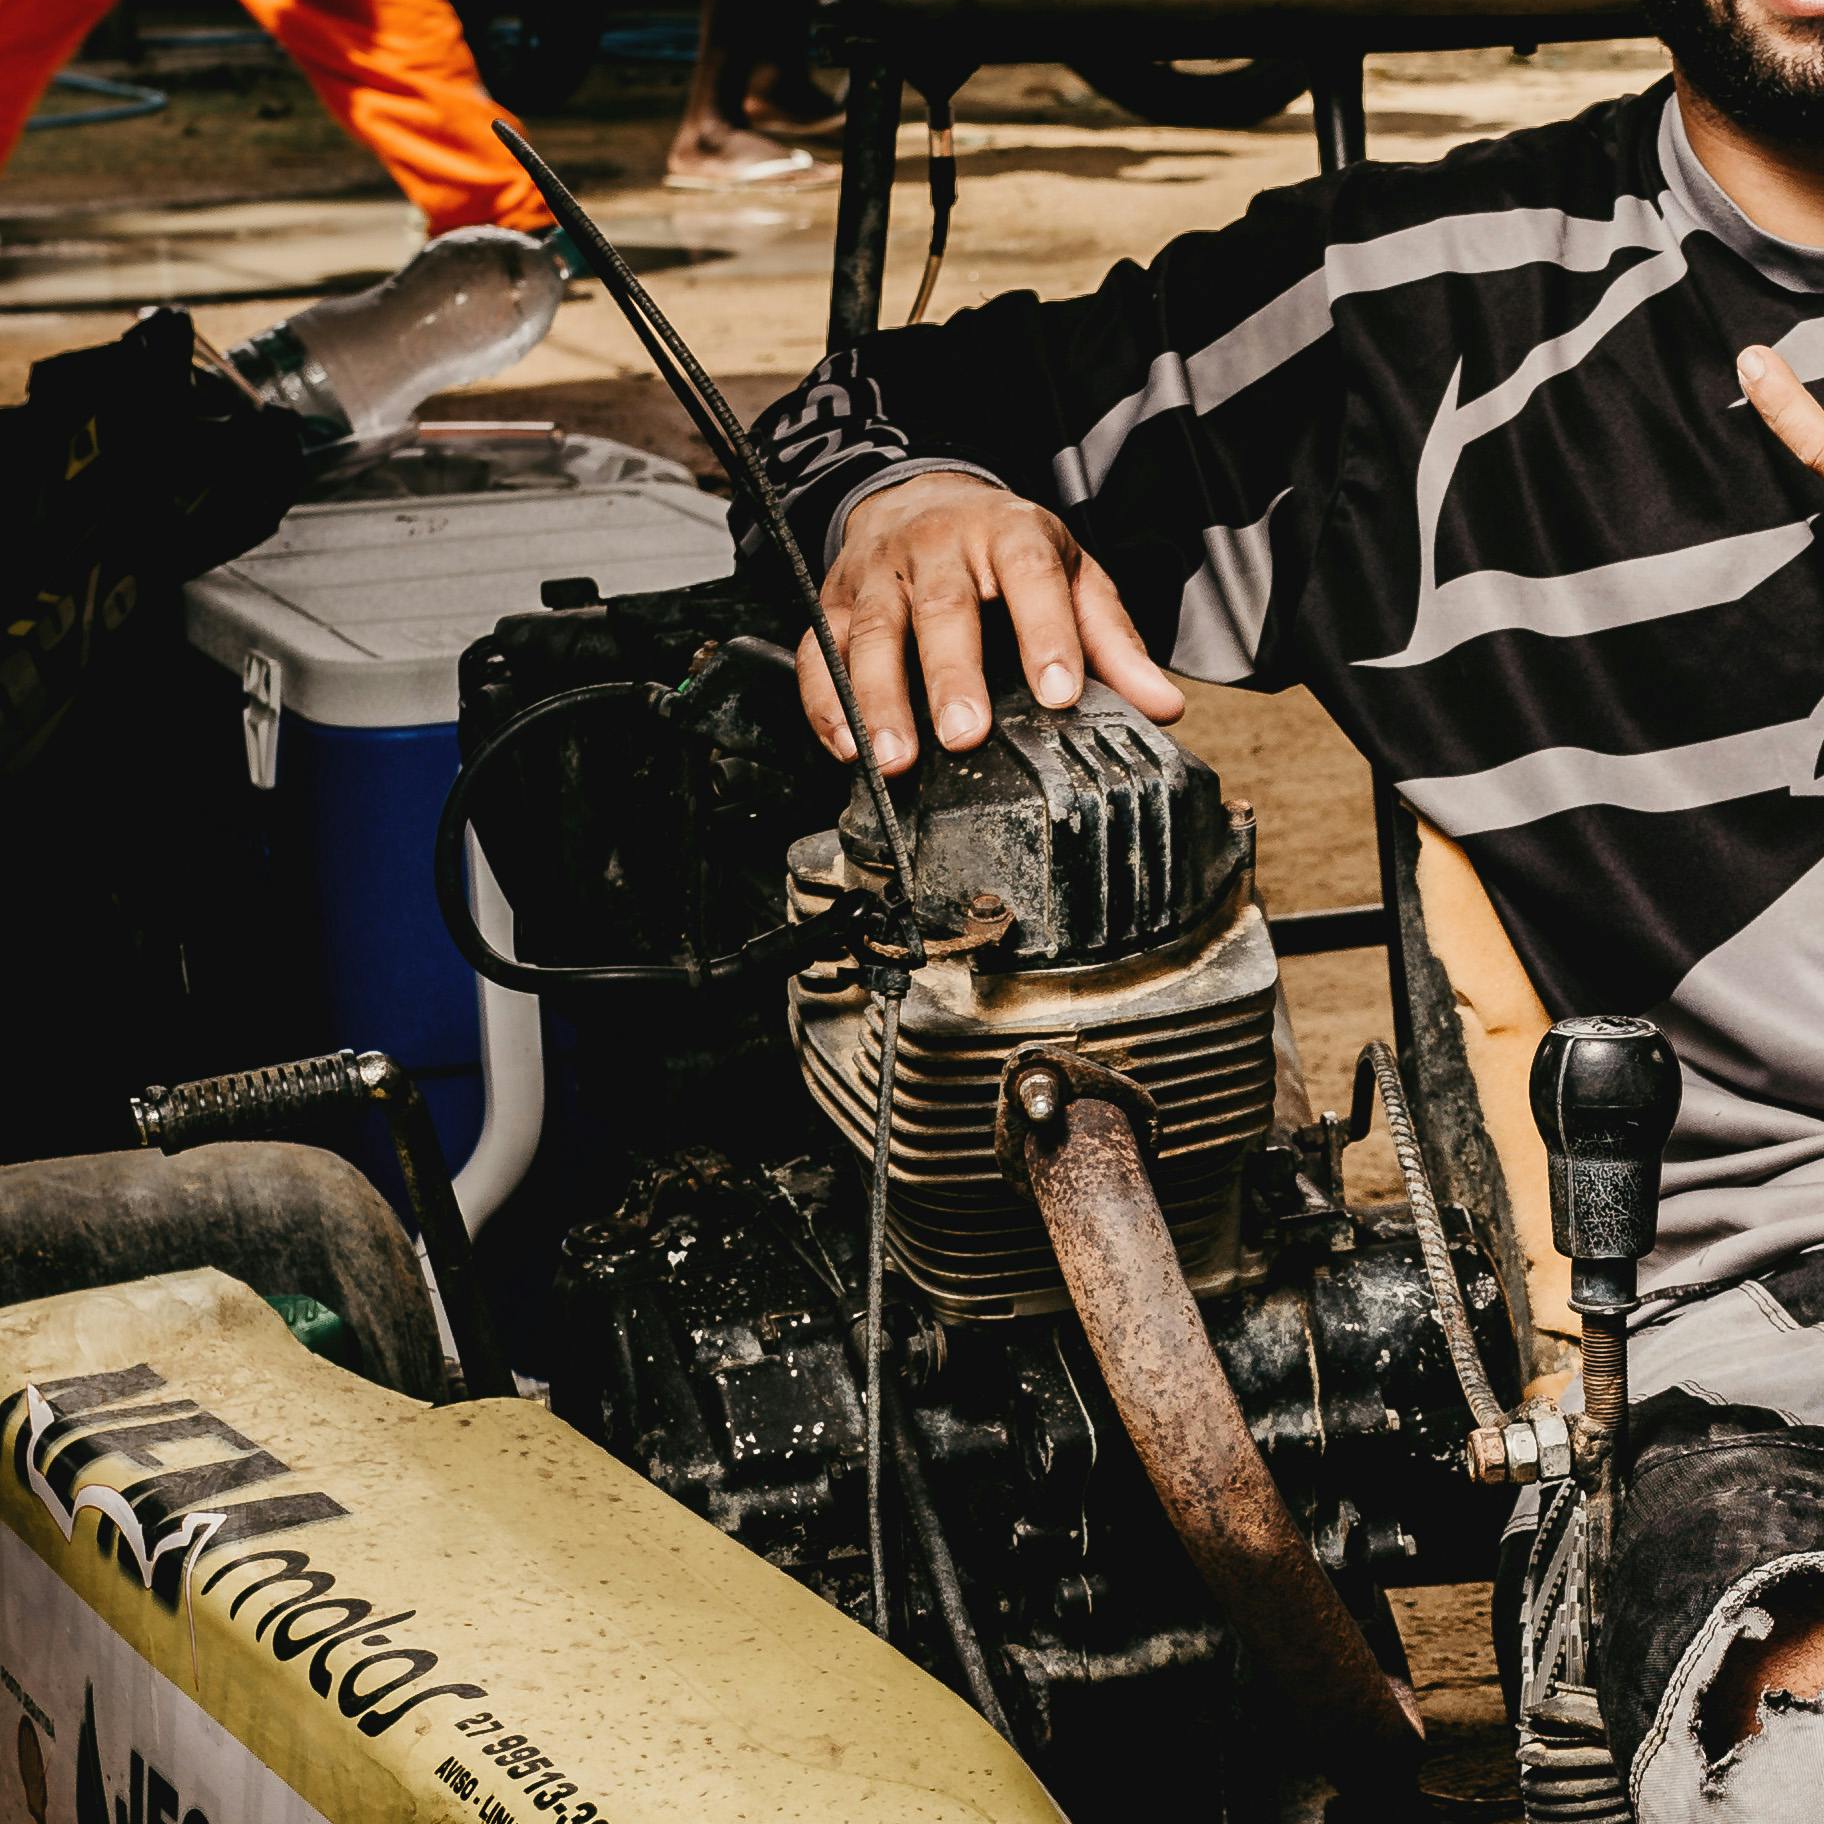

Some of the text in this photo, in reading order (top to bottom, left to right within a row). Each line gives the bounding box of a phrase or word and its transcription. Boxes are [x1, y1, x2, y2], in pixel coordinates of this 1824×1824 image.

[201, 1550, 488, 1738] motos
[454, 1712, 504, 1738] 27
[433, 1755, 480, 1802] AVISO
